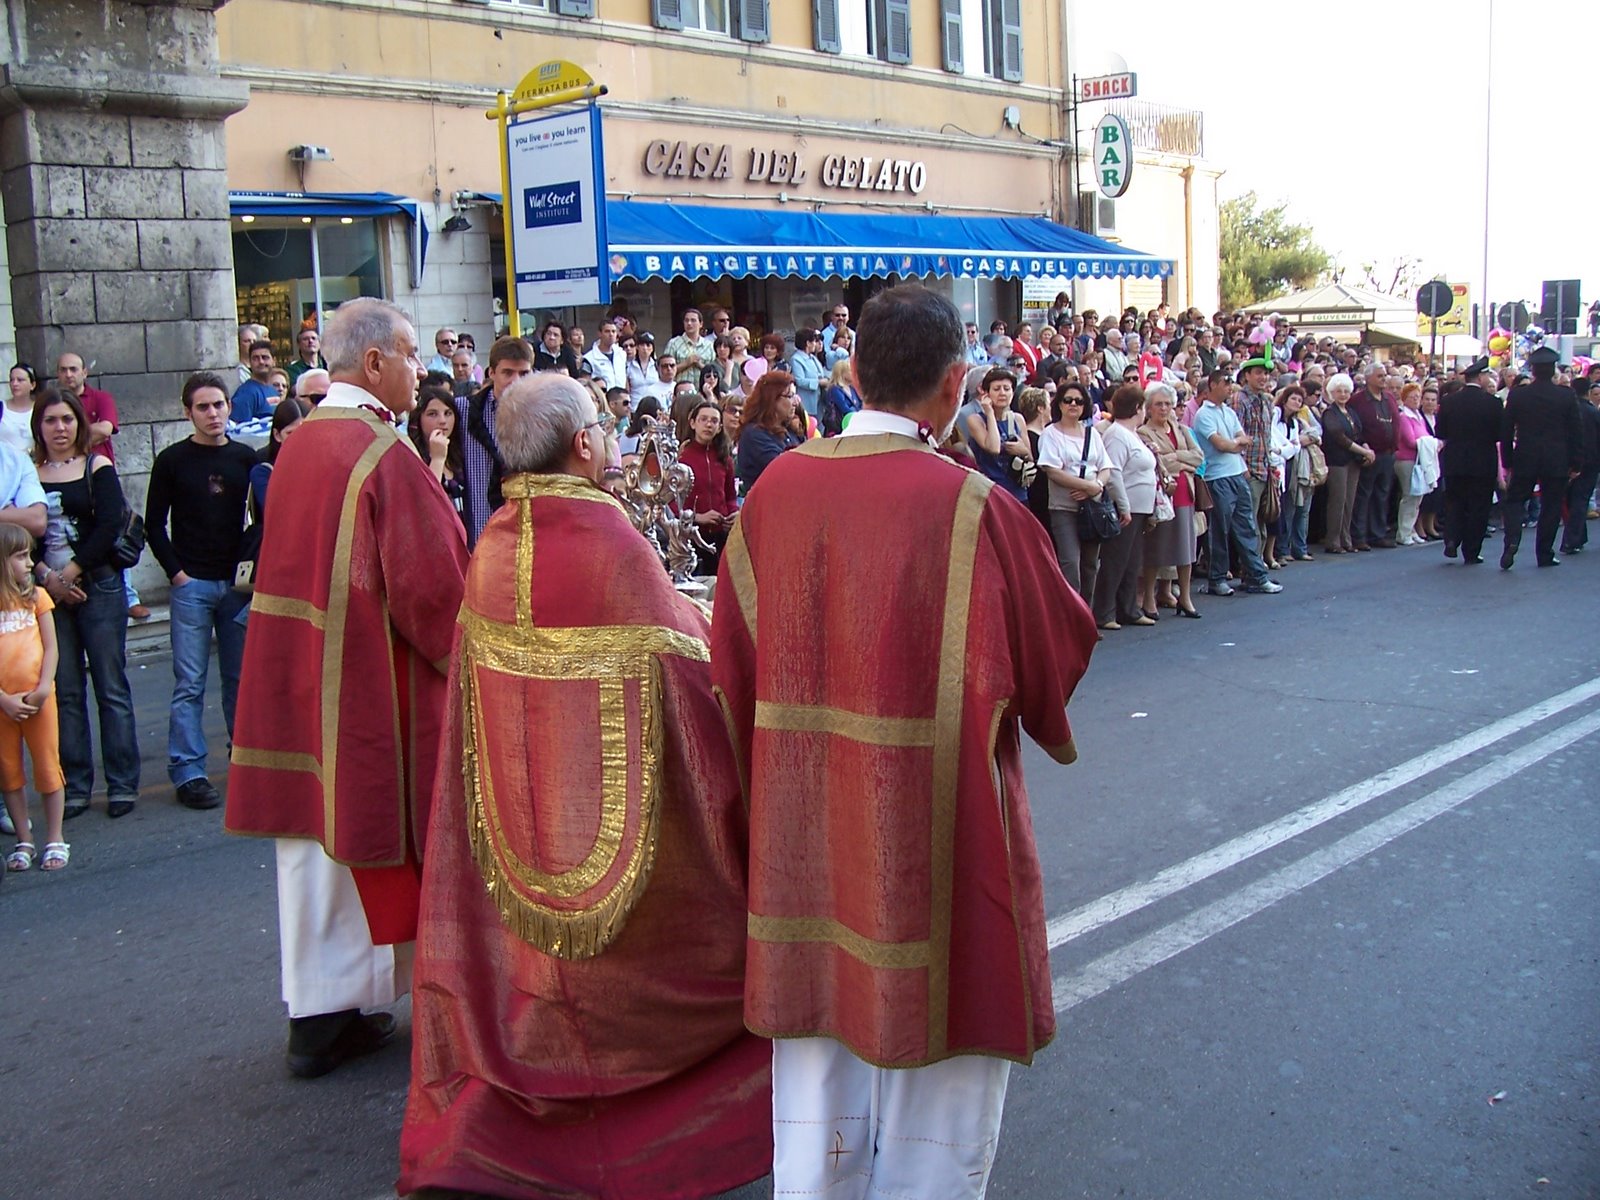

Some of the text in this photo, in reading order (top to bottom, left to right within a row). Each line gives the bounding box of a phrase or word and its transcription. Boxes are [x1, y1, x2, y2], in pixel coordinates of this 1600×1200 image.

[521, 84, 560, 98] FERMATA
[563, 79, 580, 90] BUS
[1084, 77, 1129, 97] SNACK
[515, 136, 528, 147] you
[529, 133, 541, 143] live
[552, 129, 565, 140] you
[567, 126, 586, 136] learn
[1100, 126, 1121, 187] BAR
[644, 139, 927, 194] CASA DEL GELATO
[529, 191, 576, 209] Wall Street
[536, 207, 569, 218] INSTITUTE
[724, 255, 887, 272] GELATERIA
[962, 258, 1150, 275] CASA DEL GELATO
[1313, 313, 1362, 321] SOUVENIRS
